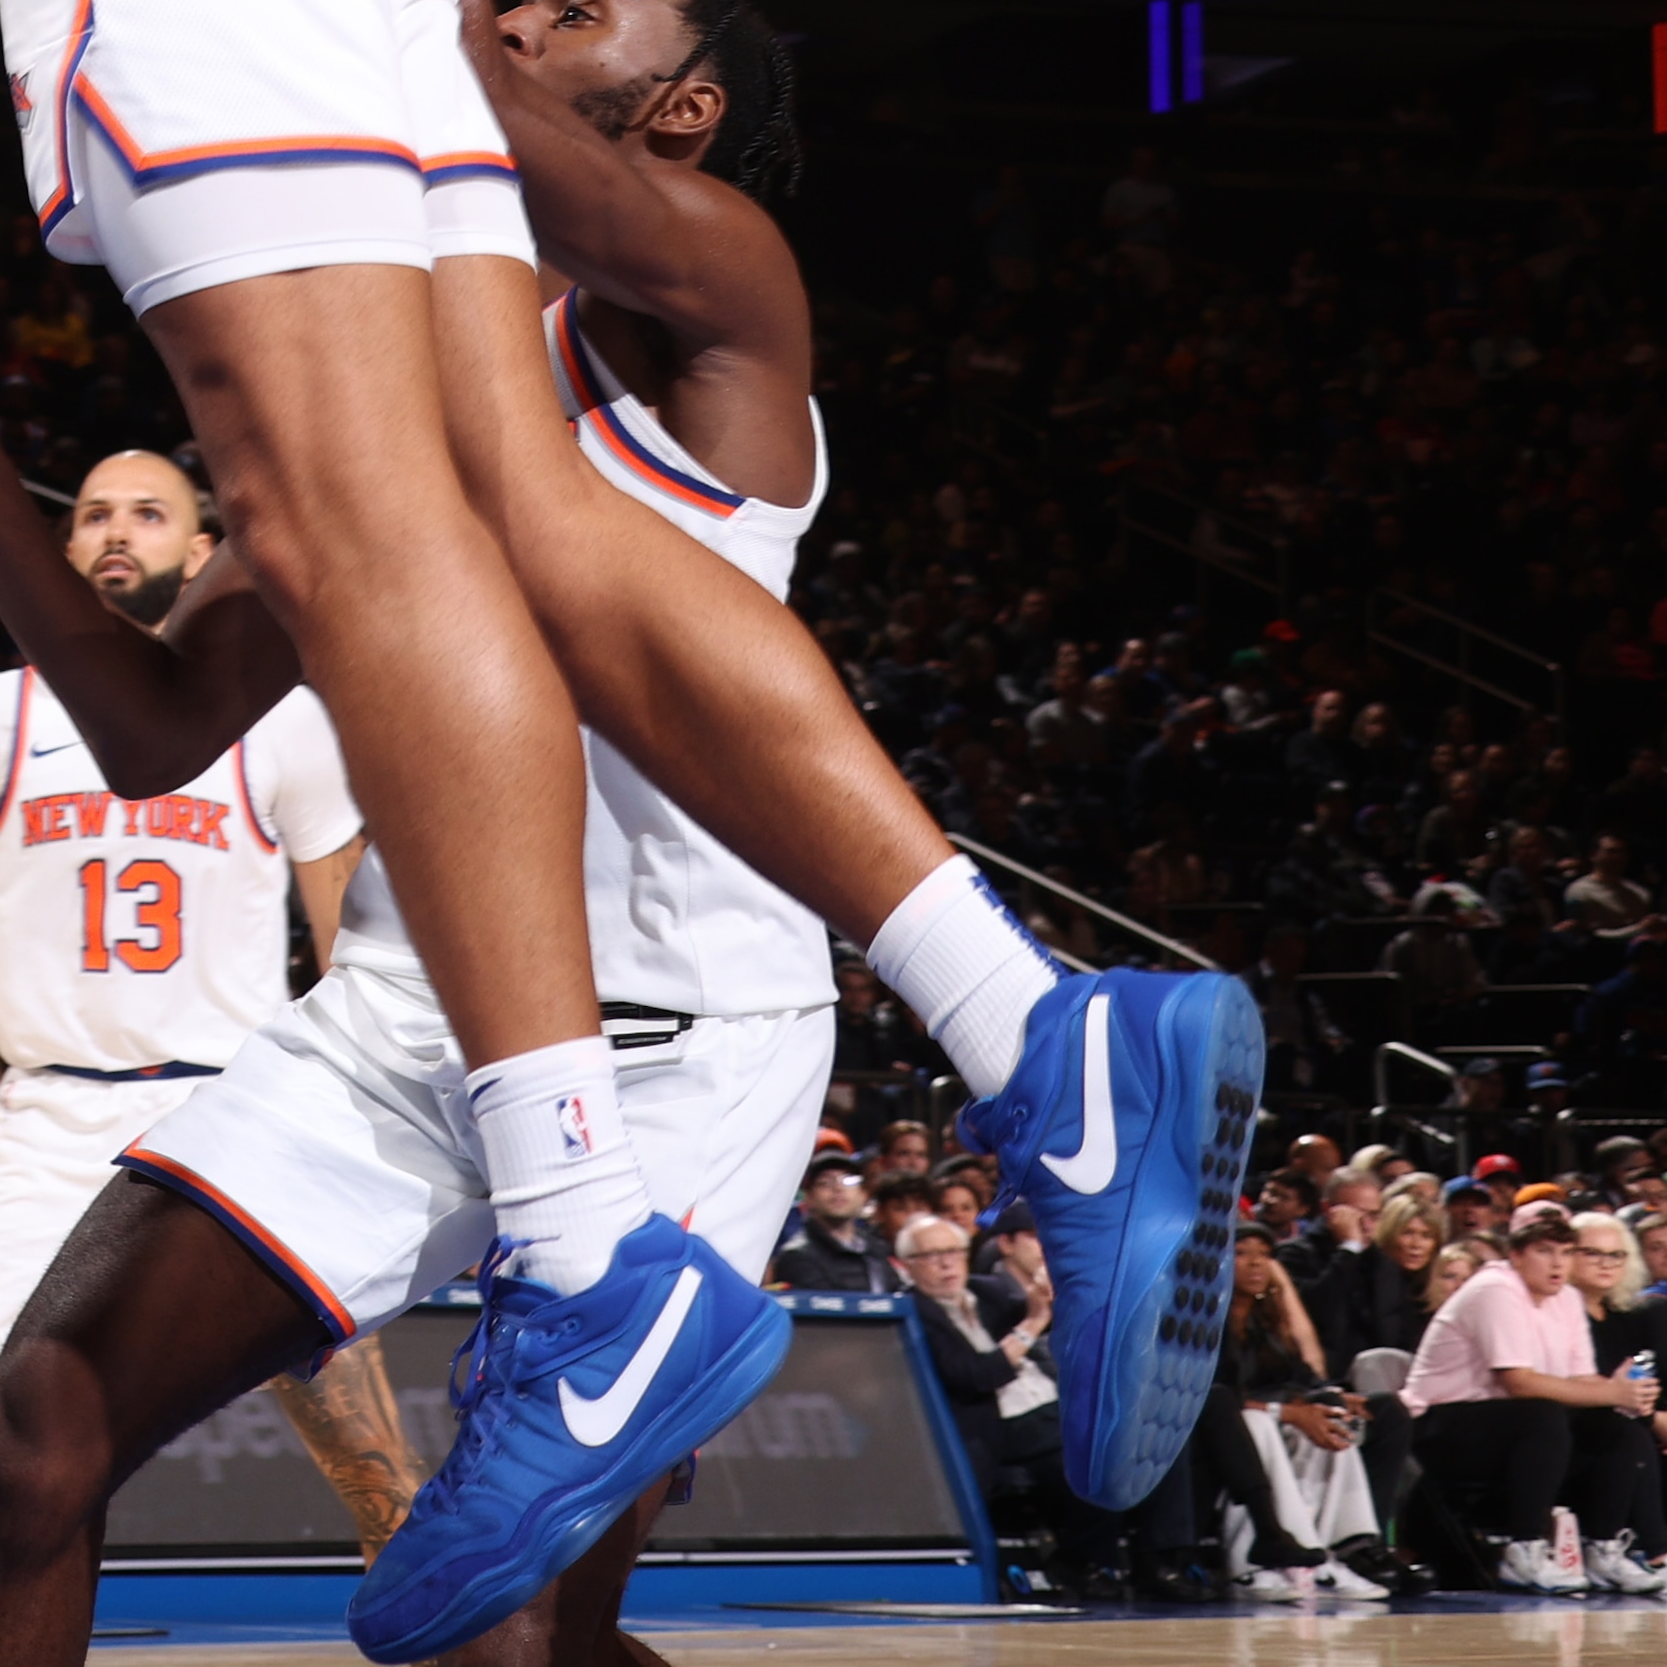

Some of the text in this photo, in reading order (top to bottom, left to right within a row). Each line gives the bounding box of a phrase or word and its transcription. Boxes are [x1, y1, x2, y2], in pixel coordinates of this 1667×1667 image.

[21, 790, 231, 852] NEW YORK
[77, 858, 183, 974] 13
